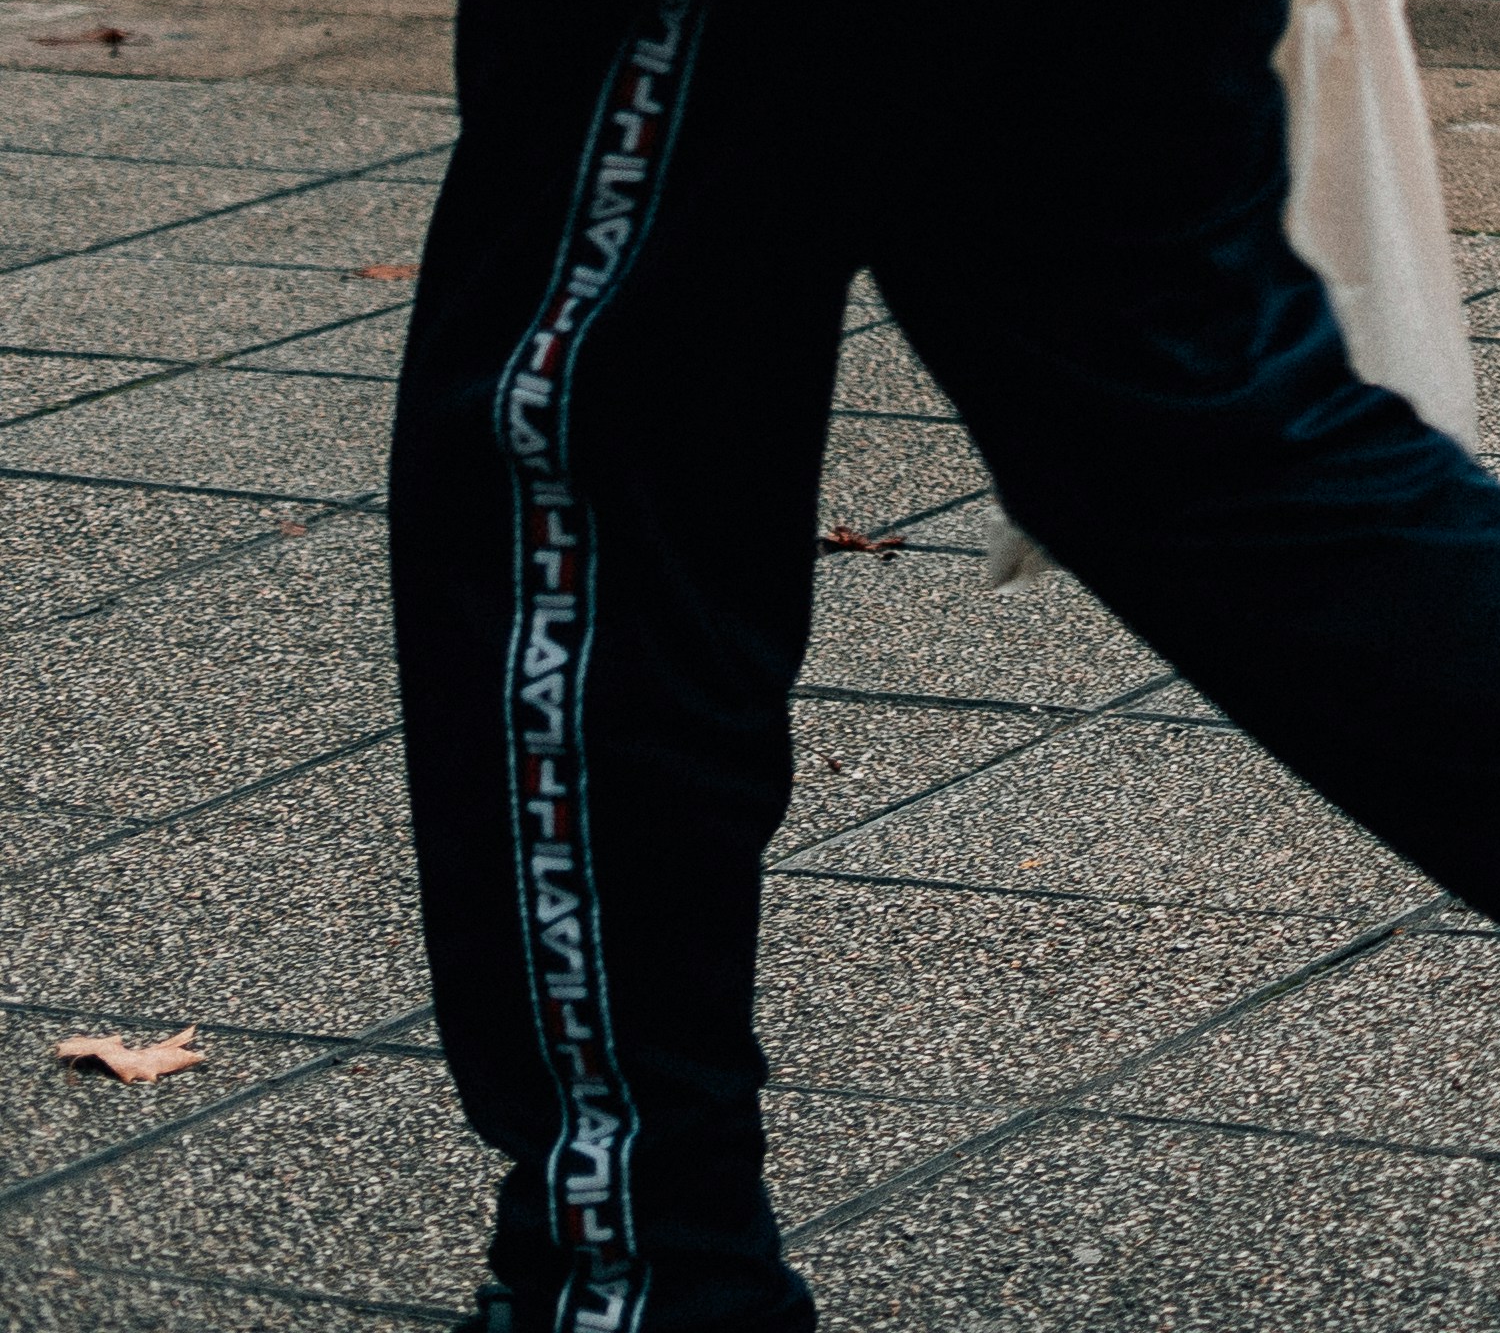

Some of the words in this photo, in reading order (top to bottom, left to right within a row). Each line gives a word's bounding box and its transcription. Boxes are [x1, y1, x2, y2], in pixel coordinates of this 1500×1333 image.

[589, 109, 659, 220] FILA
[544, 215, 632, 334] FILA
[508, 328, 563, 456] FILA
[522, 547, 577, 678] FILA
[519, 670, 572, 796] FILA
[525, 796, 581, 922] FILA
[533, 913, 595, 1040] FILA
